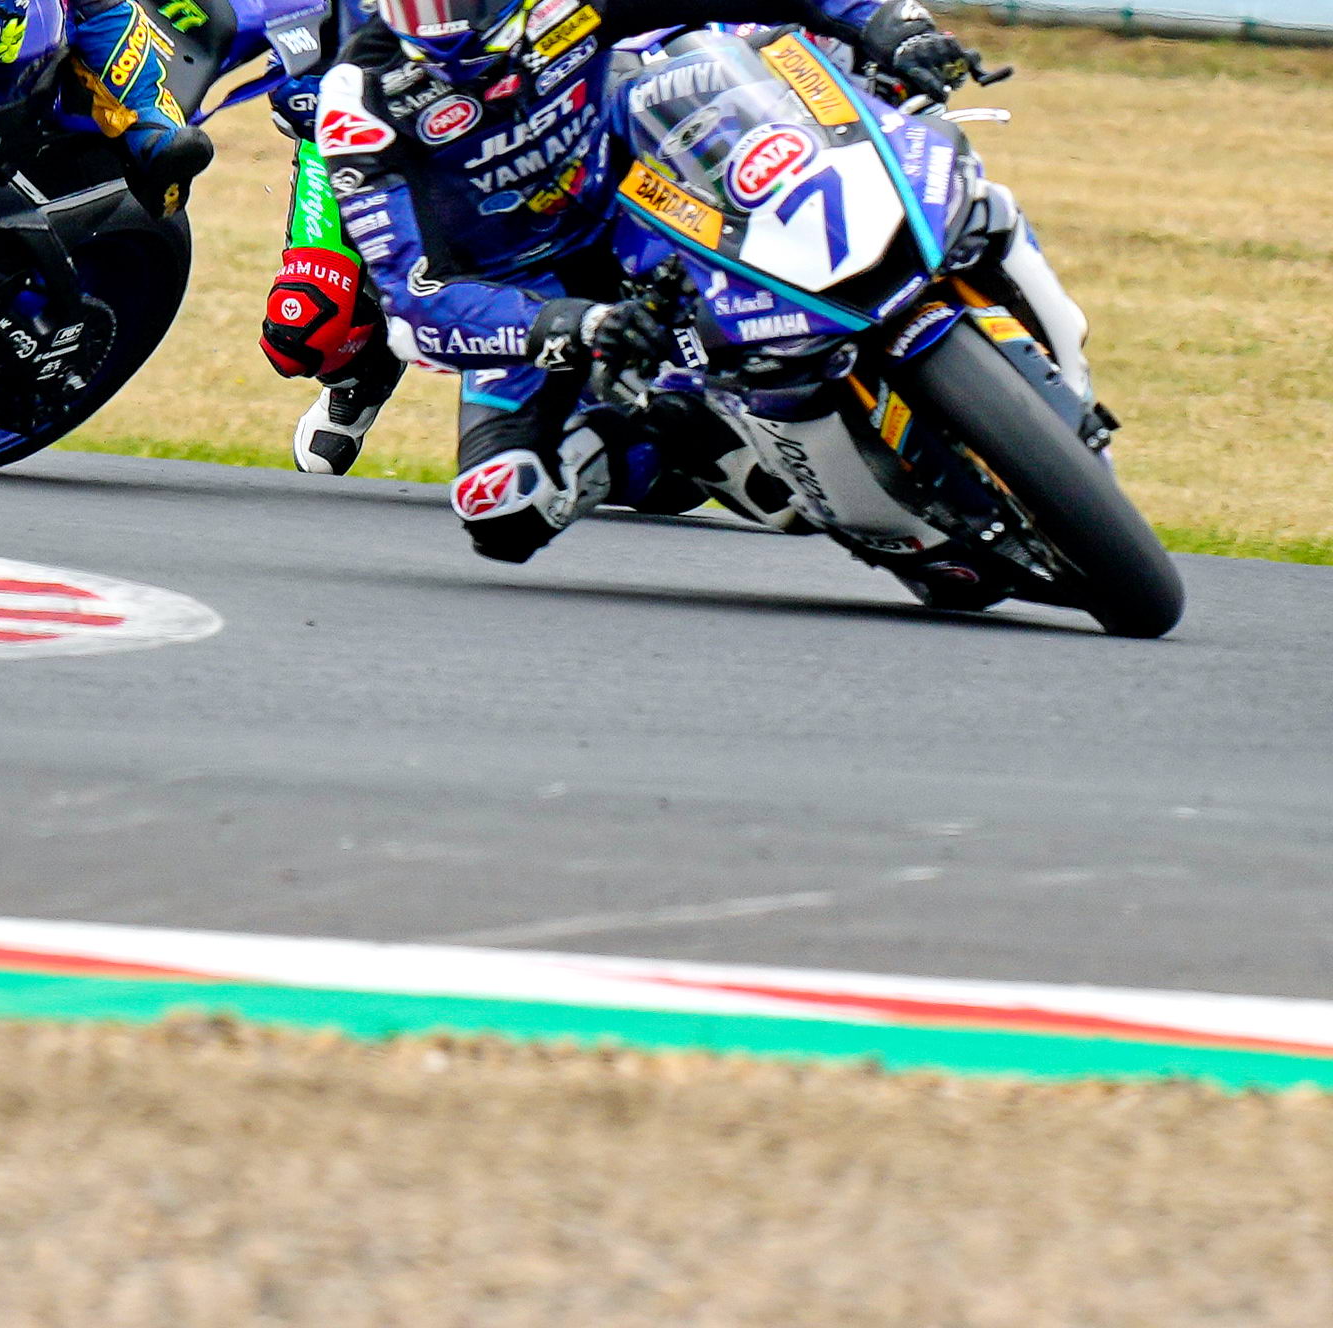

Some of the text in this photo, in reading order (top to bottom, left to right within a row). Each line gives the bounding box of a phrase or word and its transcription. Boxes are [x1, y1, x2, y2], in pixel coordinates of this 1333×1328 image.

[469, 103, 600, 195] YAMAHA
[306, 157, 333, 245] Ninja
[774, 165, 850, 274] 7
[417, 326, 527, 357] Si Anelli
[736, 312, 811, 342] YAMAHA
